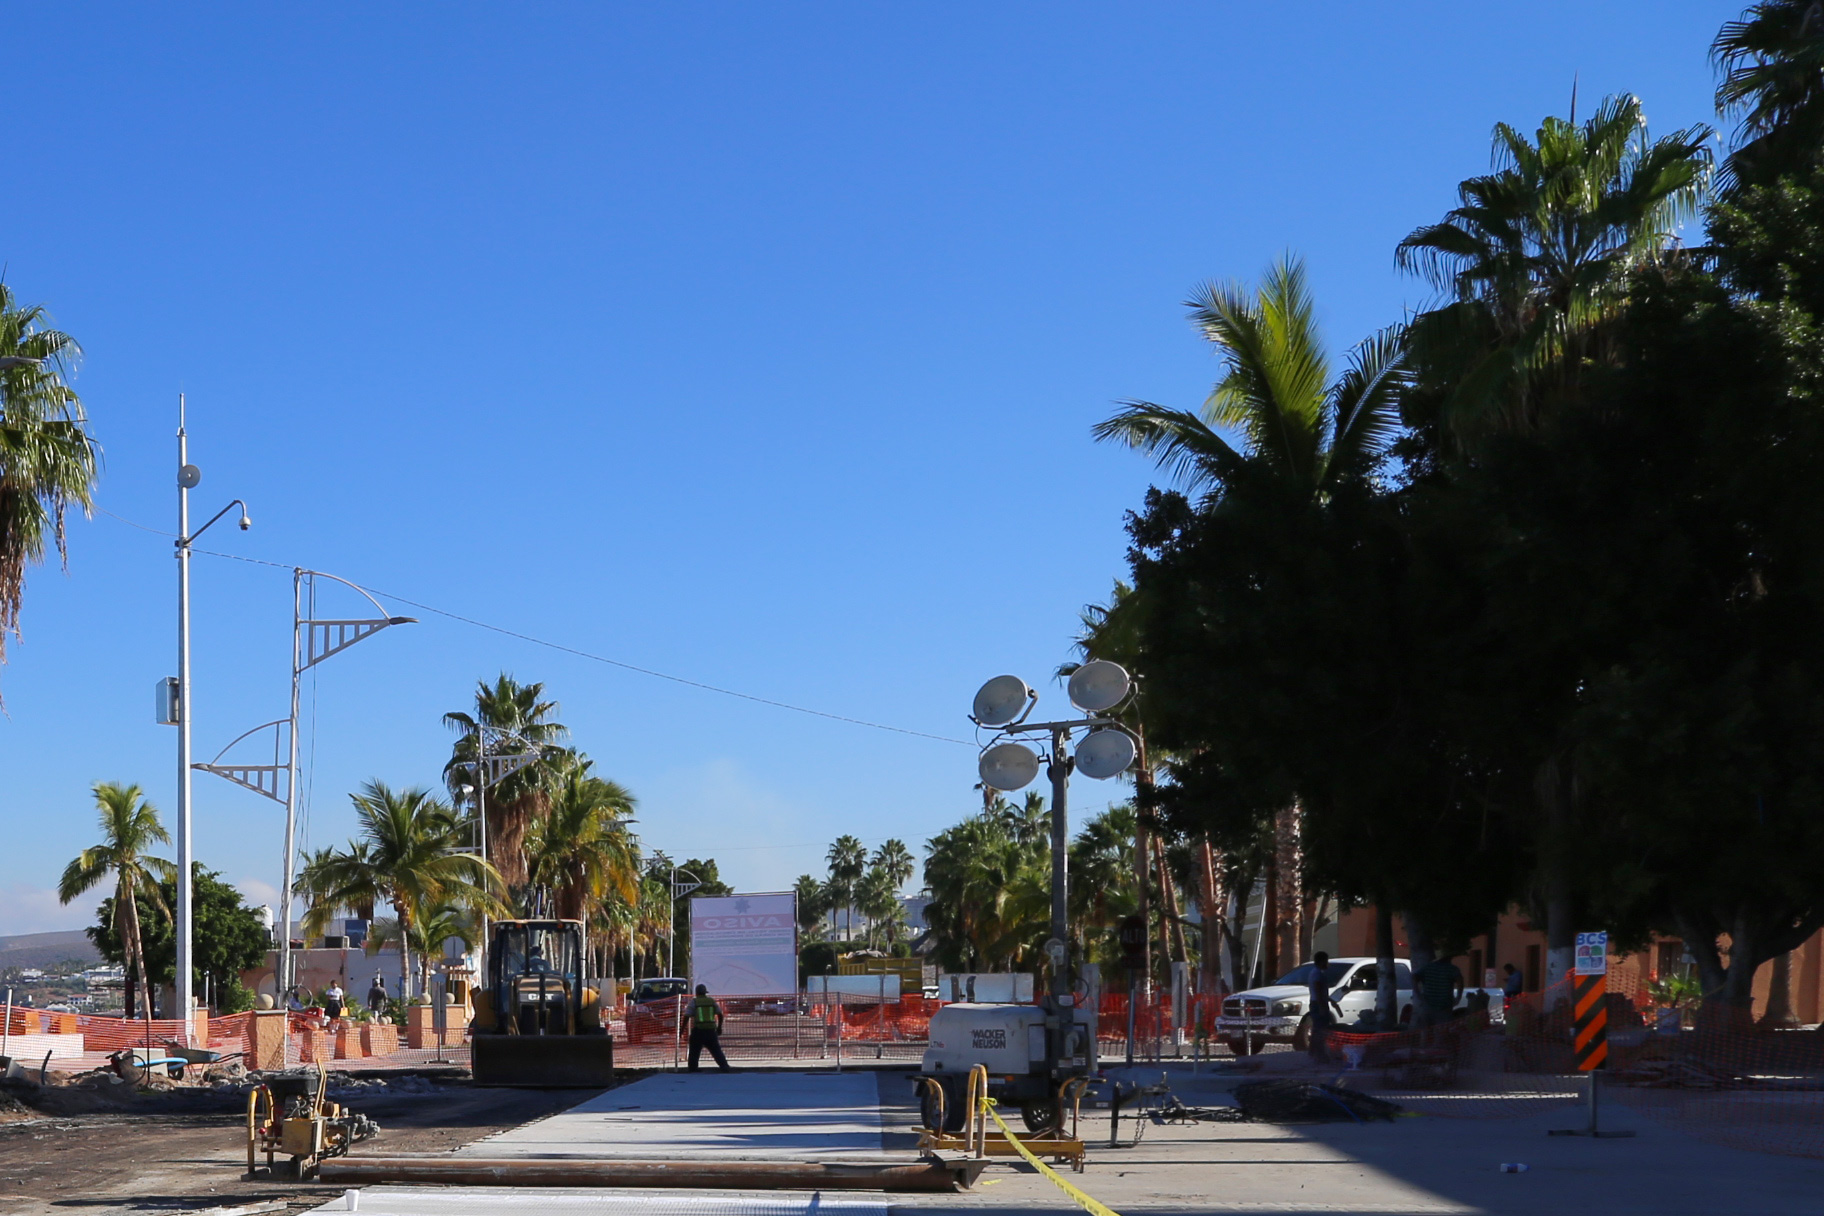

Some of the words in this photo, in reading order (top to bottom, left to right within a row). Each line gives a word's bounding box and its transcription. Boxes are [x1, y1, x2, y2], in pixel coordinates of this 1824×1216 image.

[1122, 928, 1145, 944] ALTO
[1577, 932, 1606, 945] BCS
[973, 1029, 1006, 1038] WACKER
[972, 1039, 1006, 1049] NEUSON
